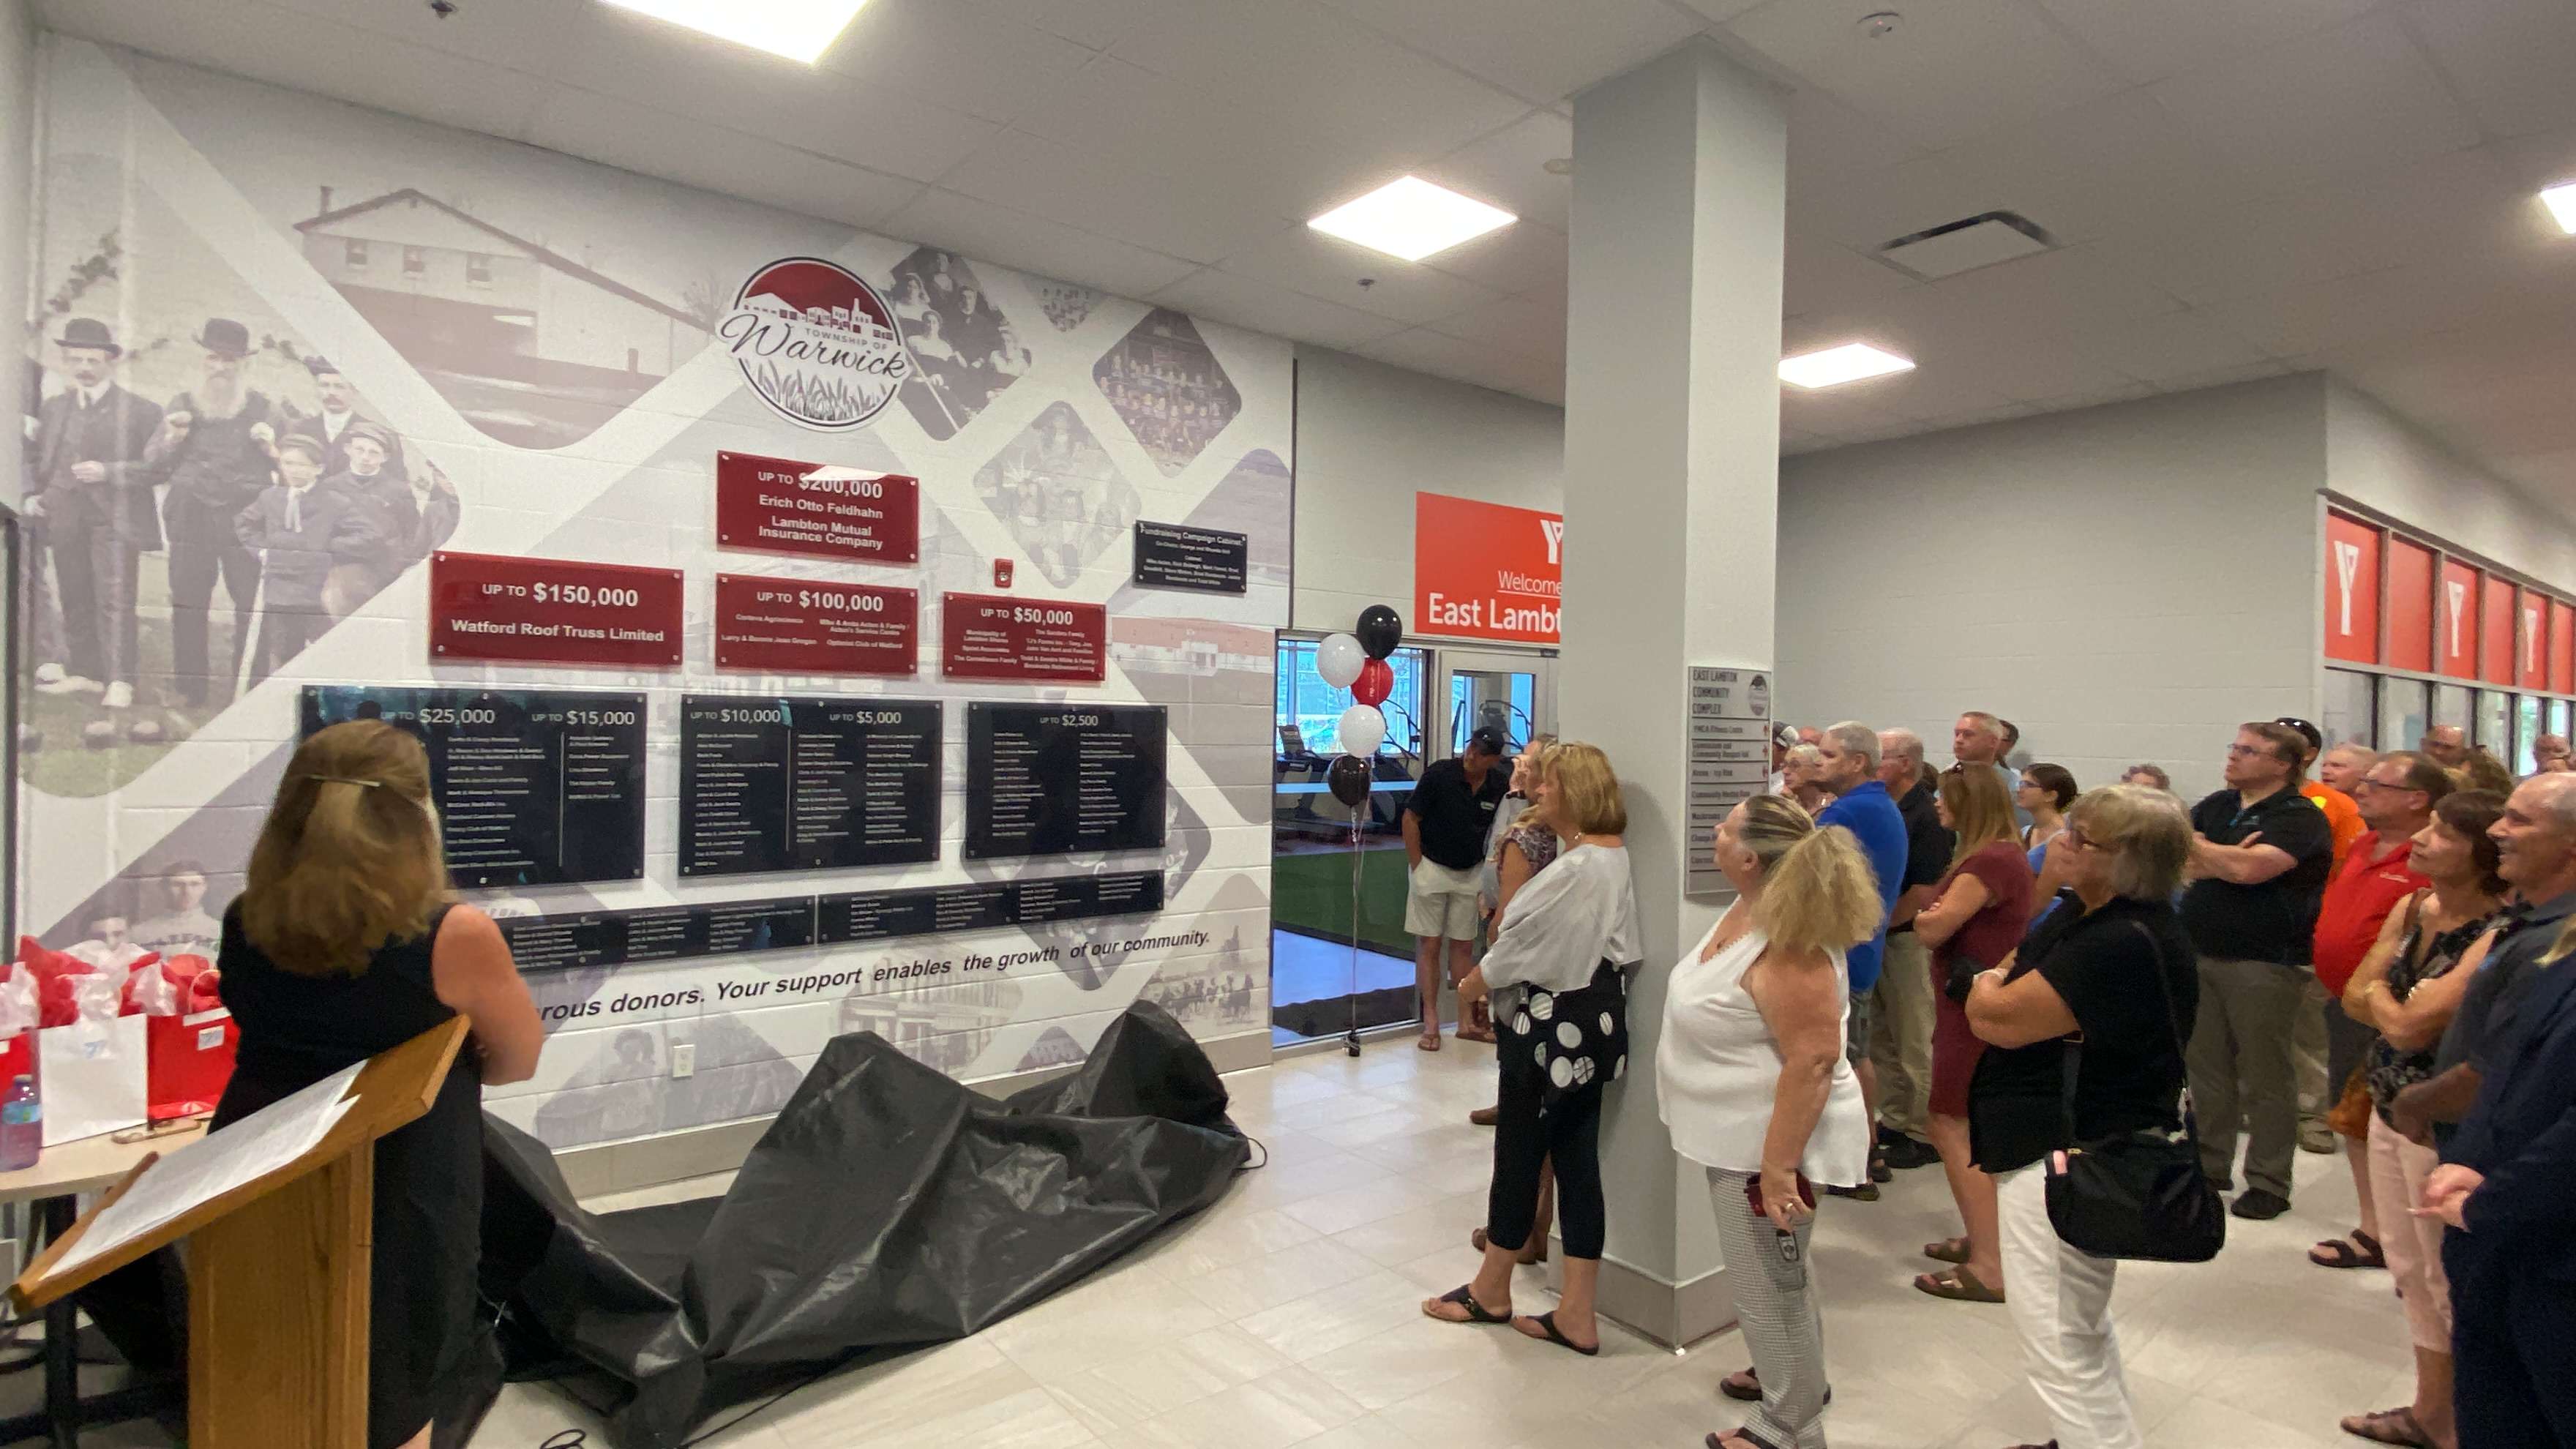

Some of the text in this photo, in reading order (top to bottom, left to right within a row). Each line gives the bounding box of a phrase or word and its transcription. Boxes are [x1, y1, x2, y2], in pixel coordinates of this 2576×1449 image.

[720, 313, 907, 379] Warwick
[806, 328, 888, 351] TOWNSHIP OF
[757, 471, 883, 499] UP TO $200,000
[759, 494, 794, 509] Erich
[796, 498, 824, 512] Otto
[771, 514, 872, 538] Lambton Mutual
[1183, 531, 1216, 544] Campaign
[758, 525, 883, 552] Insurance Company
[1498, 570, 1563, 595] Welcome
[482, 582, 639, 607] UP TO $150,000
[756, 590, 884, 613] UP TO $100,000
[981, 607, 1074, 626] UP TO $50,000
[1429, 591, 1481, 628] East
[452, 618, 664, 642] Watford Roof Truss Limited
[398, 711, 415, 721] TO
[419, 708, 496, 726] $25,000
[531, 710, 636, 727] UP TO $15,000
[691, 709, 781, 724] UP TO $10,000
[842, 714, 854, 722] TO
[856, 711, 902, 725] $5,000
[1062, 714, 1098, 727] $2,500
[540, 929, 1210, 1022] rous donors. Your support enables the growth of our community.
